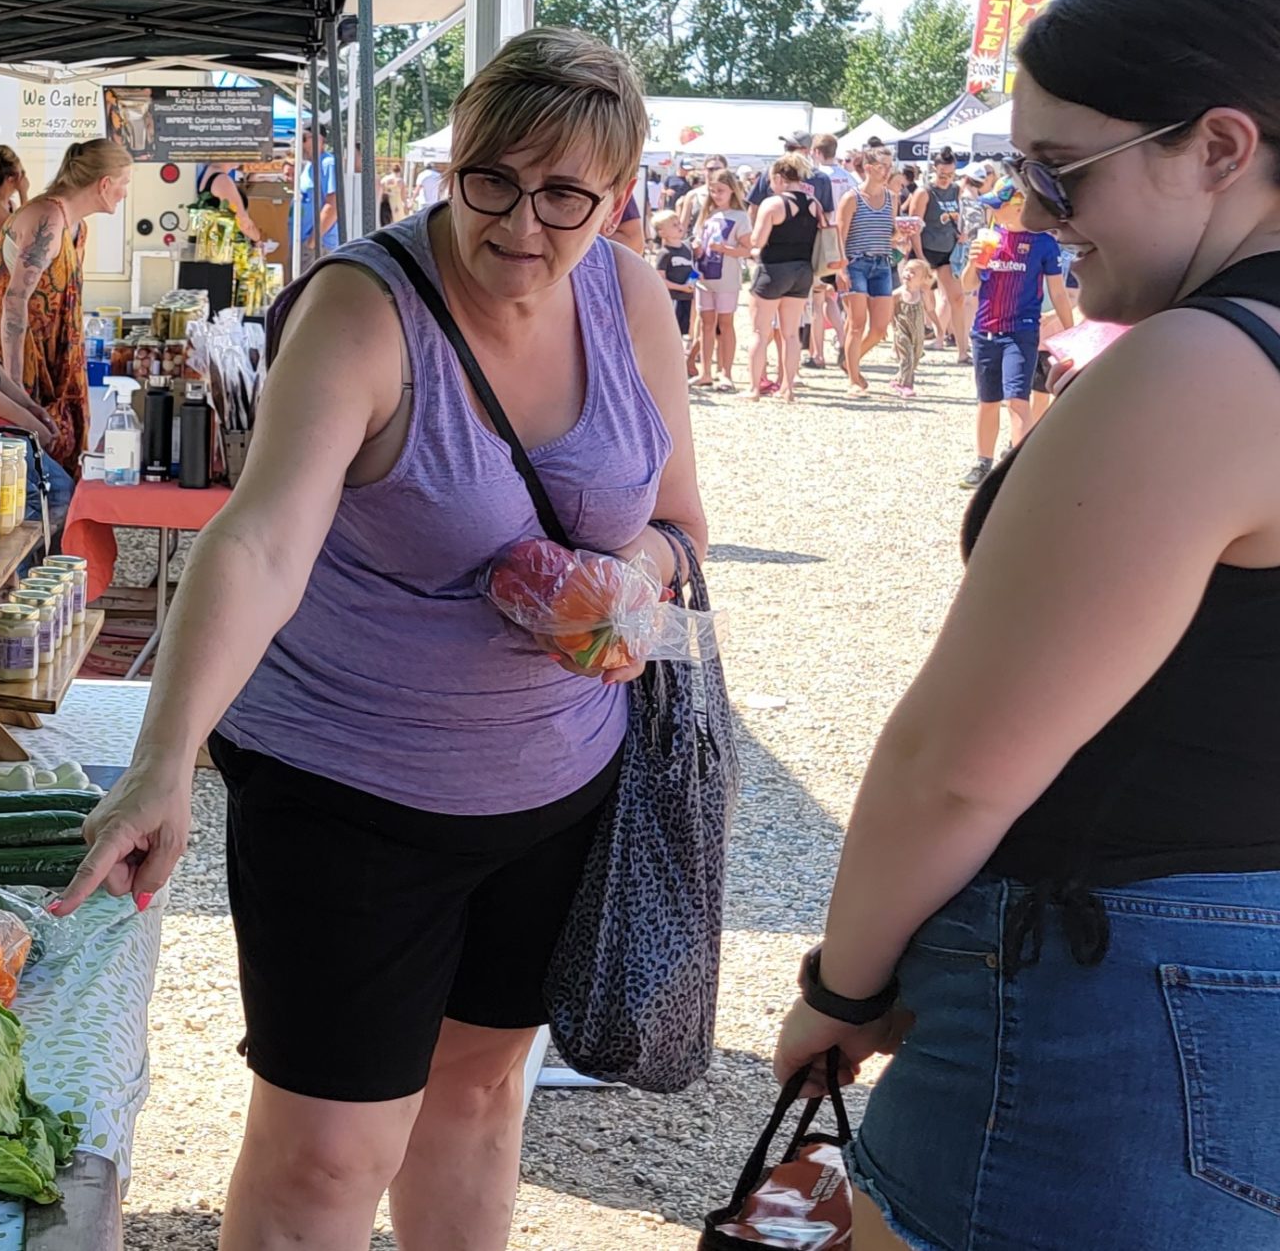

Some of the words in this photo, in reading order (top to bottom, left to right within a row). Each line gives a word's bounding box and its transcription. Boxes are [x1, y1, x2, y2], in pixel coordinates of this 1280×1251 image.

[23, 89, 46, 105] We
[50, 89, 98, 107] Cater!
[21, 118, 97, 128] 587-457-0799
[987, 258, 1027, 273] akuten
